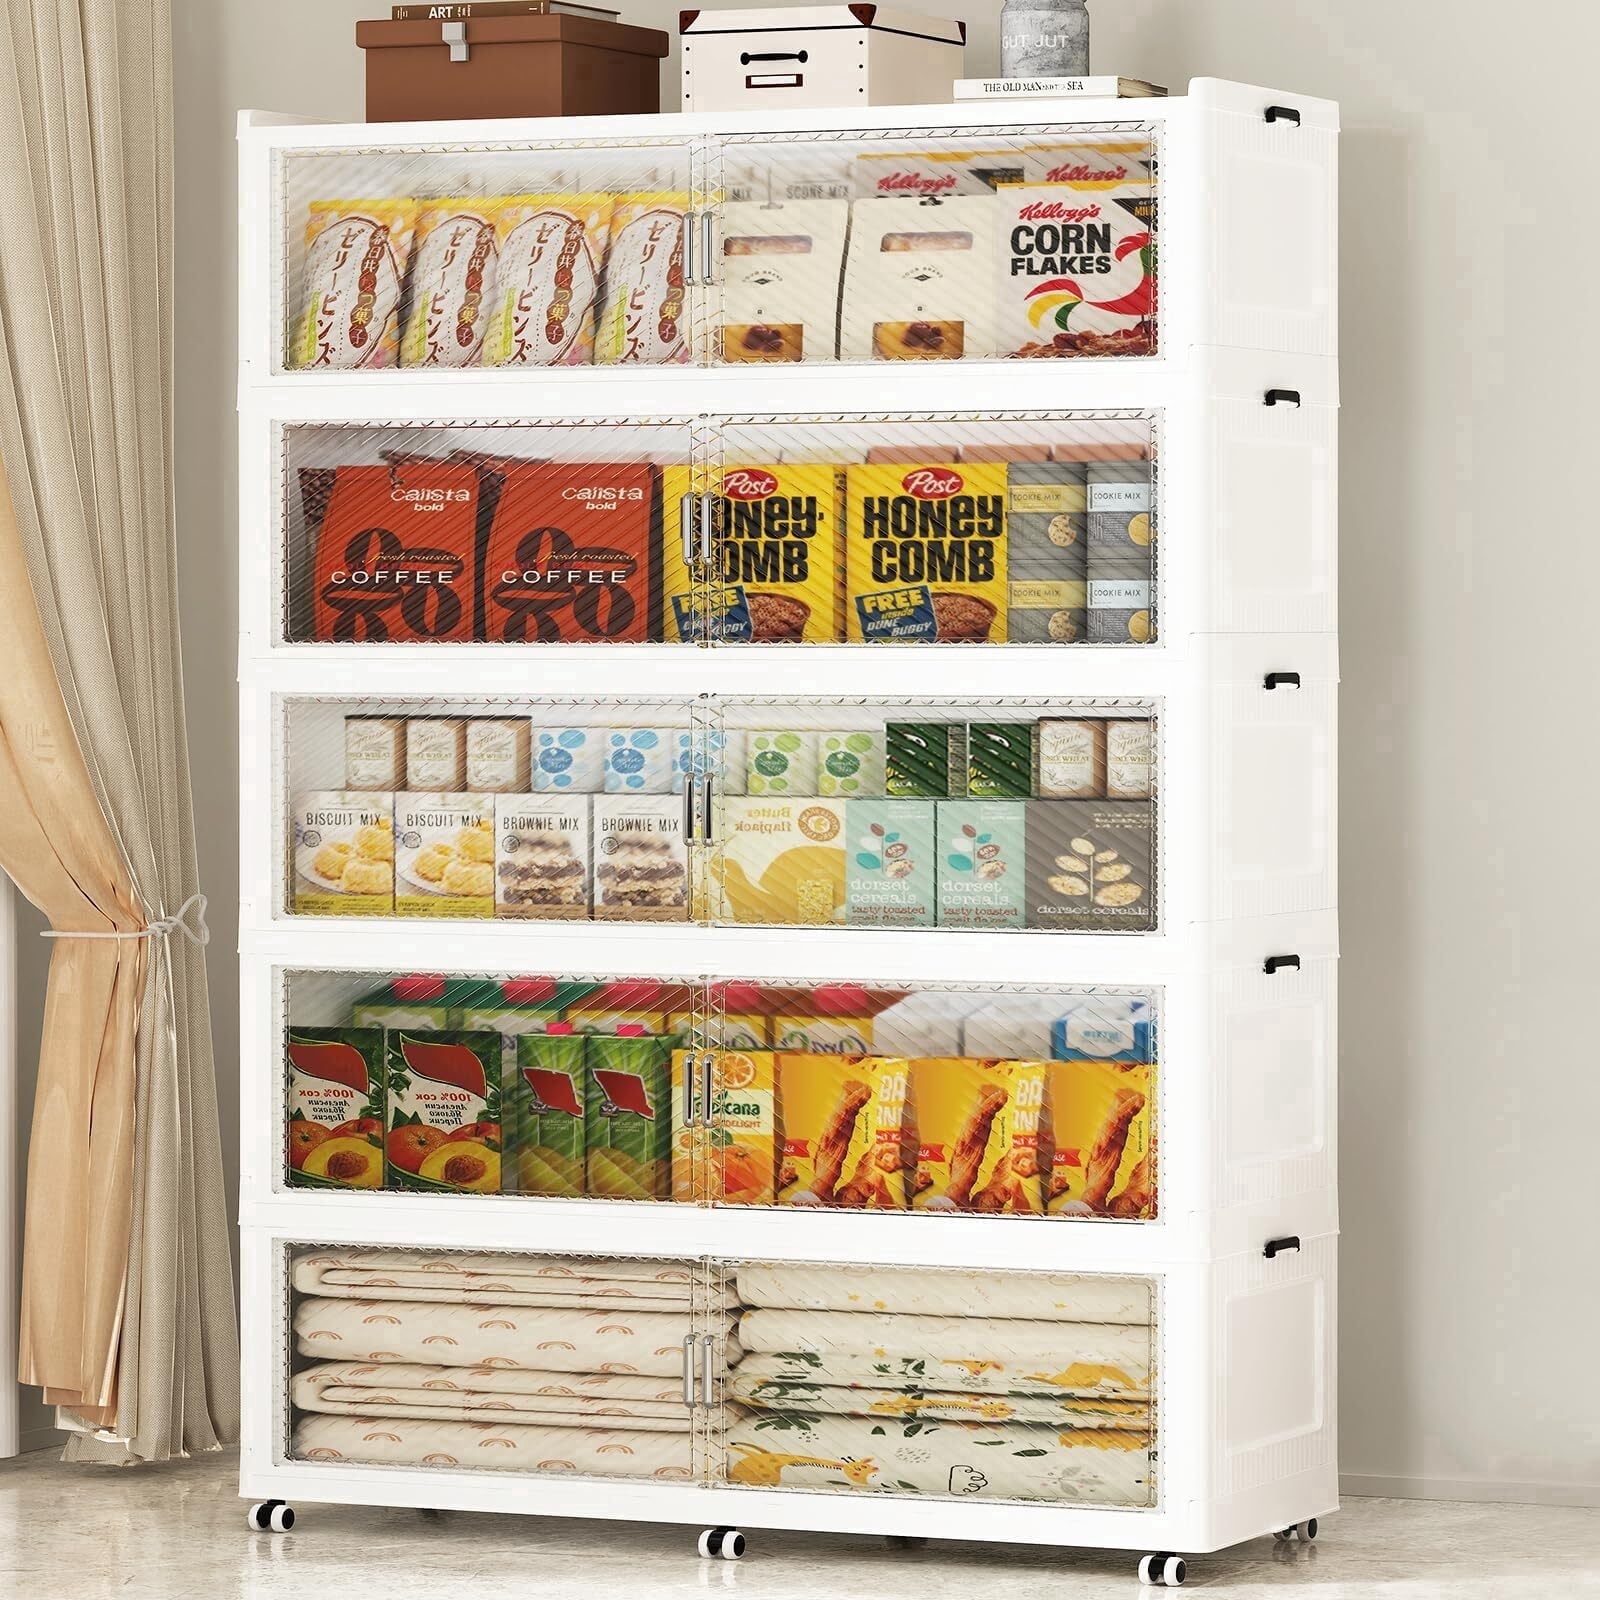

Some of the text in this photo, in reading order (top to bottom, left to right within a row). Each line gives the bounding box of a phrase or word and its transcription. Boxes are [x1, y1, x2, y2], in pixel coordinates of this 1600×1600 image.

[428, 6, 453, 19] ART
[1035, 34, 1069, 48] JUT
[984, 83, 1001, 93] THE
[1003, 82, 1021, 92] OLD
[1023, 81, 1042, 92] MAN
[1067, 81, 1084, 91] SEA
[1018, 201, 1101, 223] Kellogg's
[1010, 223, 1111, 256] CORN
[1011, 255, 1112, 276] FLAKES
[725, 472, 775, 495] Post
[907, 471, 960, 494] Post
[1094, 492, 1122, 500] COOKIE
[414, 503, 444, 511] bold
[586, 502, 617, 510] bold
[689, 540, 808, 583] OMB
[872, 539, 995, 583] COMB
[331, 570, 453, 584] COFFEE
[501, 570, 627, 584] COFFEE
[1094, 589, 1141, 597] COOKIE MIX
[862, 588, 925, 614] FREE
[306, 813, 381, 826] BISCUIT MIX
[406, 814, 482, 827] BISCUIT MIX
[503, 817, 579, 830] BROWNIE MIX
[602, 818, 679, 832] BROWNIE MIX
[851, 879, 910, 891] dorset
[943, 880, 1002, 892] dorset
[851, 892, 917, 904] cereals
[943, 893, 1009, 905] cereals
[884, 906, 926, 915] toasted
[975, 907, 1018, 916] toasted
